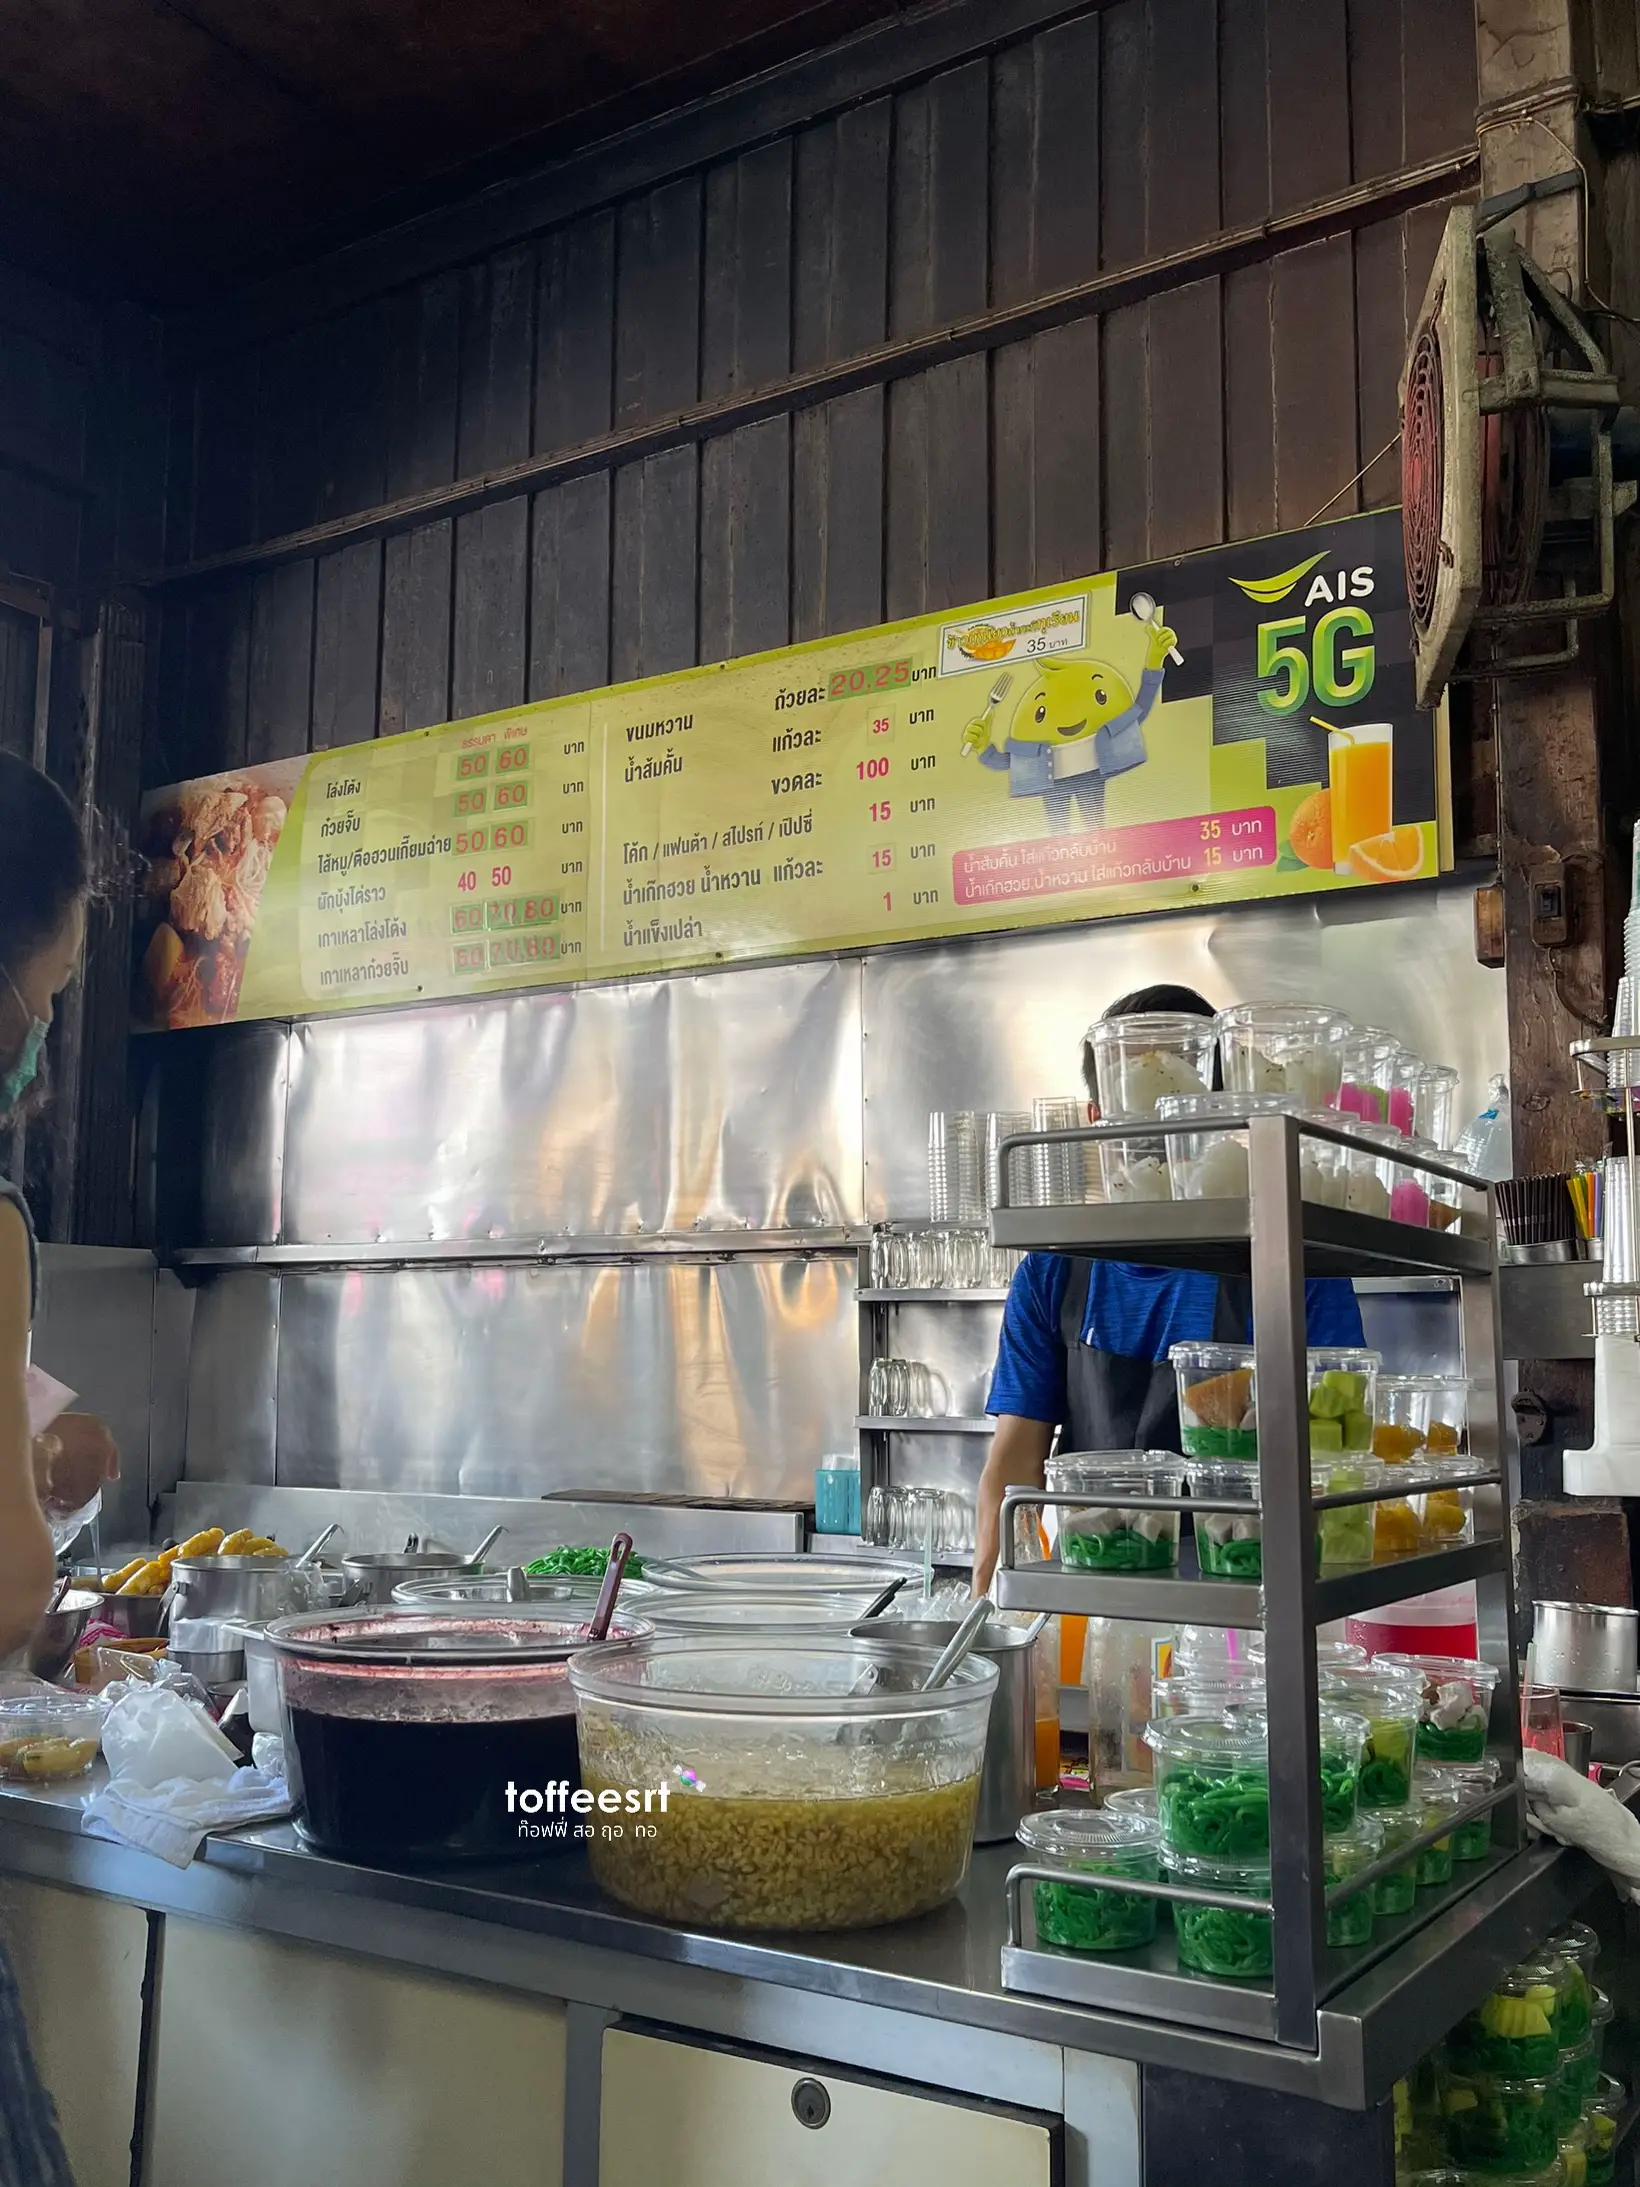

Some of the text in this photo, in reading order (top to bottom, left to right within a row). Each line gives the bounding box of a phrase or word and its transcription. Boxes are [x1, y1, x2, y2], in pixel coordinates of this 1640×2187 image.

[1305, 566, 1375, 607] AIS
[1027, 637, 1068, 653] 35 บาท
[1257, 606, 1376, 716] 5G
[626, 661, 937, 742] ขนมหวาน ถ้วยละ 20,25 บาท
[460, 755, 487, 778] 50
[498, 748, 527, 770] 60
[564, 741, 584, 755] บาท
[624, 707, 935, 783] น้ำส้มคั้น แก้วละ 35 บาท
[771, 753, 936, 795] ขวดละ 100 บาท
[321, 781, 584, 838] ก๋วยจั๊บ 50 60 บาท
[623, 841, 648, 864] โค้ก
[663, 832, 708, 859] แฟนต้า
[722, 821, 764, 848] สไปรท์
[869, 801, 892, 823] 15
[910, 796, 936, 814] บาท
[1200, 819, 1221, 841] 35
[1231, 818, 1263, 836] บาท
[455, 831, 485, 855] 50
[494, 824, 525, 850] 60
[562, 821, 583, 835] บาท
[1204, 846, 1222, 867] 15
[1232, 844, 1263, 863] บาท
[317, 861, 583, 914] ผักบุ้งไต่ราว 40 50 บาท
[623, 843, 936, 906] น้ำเก๊กฮวย น้ำหวาน แก้วละ 15 บาท
[454, 908, 482, 930] 60
[560, 901, 582, 915] บาท
[623, 889, 939, 947] น้ำแข็งเปล่า 1 บาท
[320, 951, 409, 985] เกาเหลาก๋วยจั๊บ
[561, 941, 582, 955] บาท
